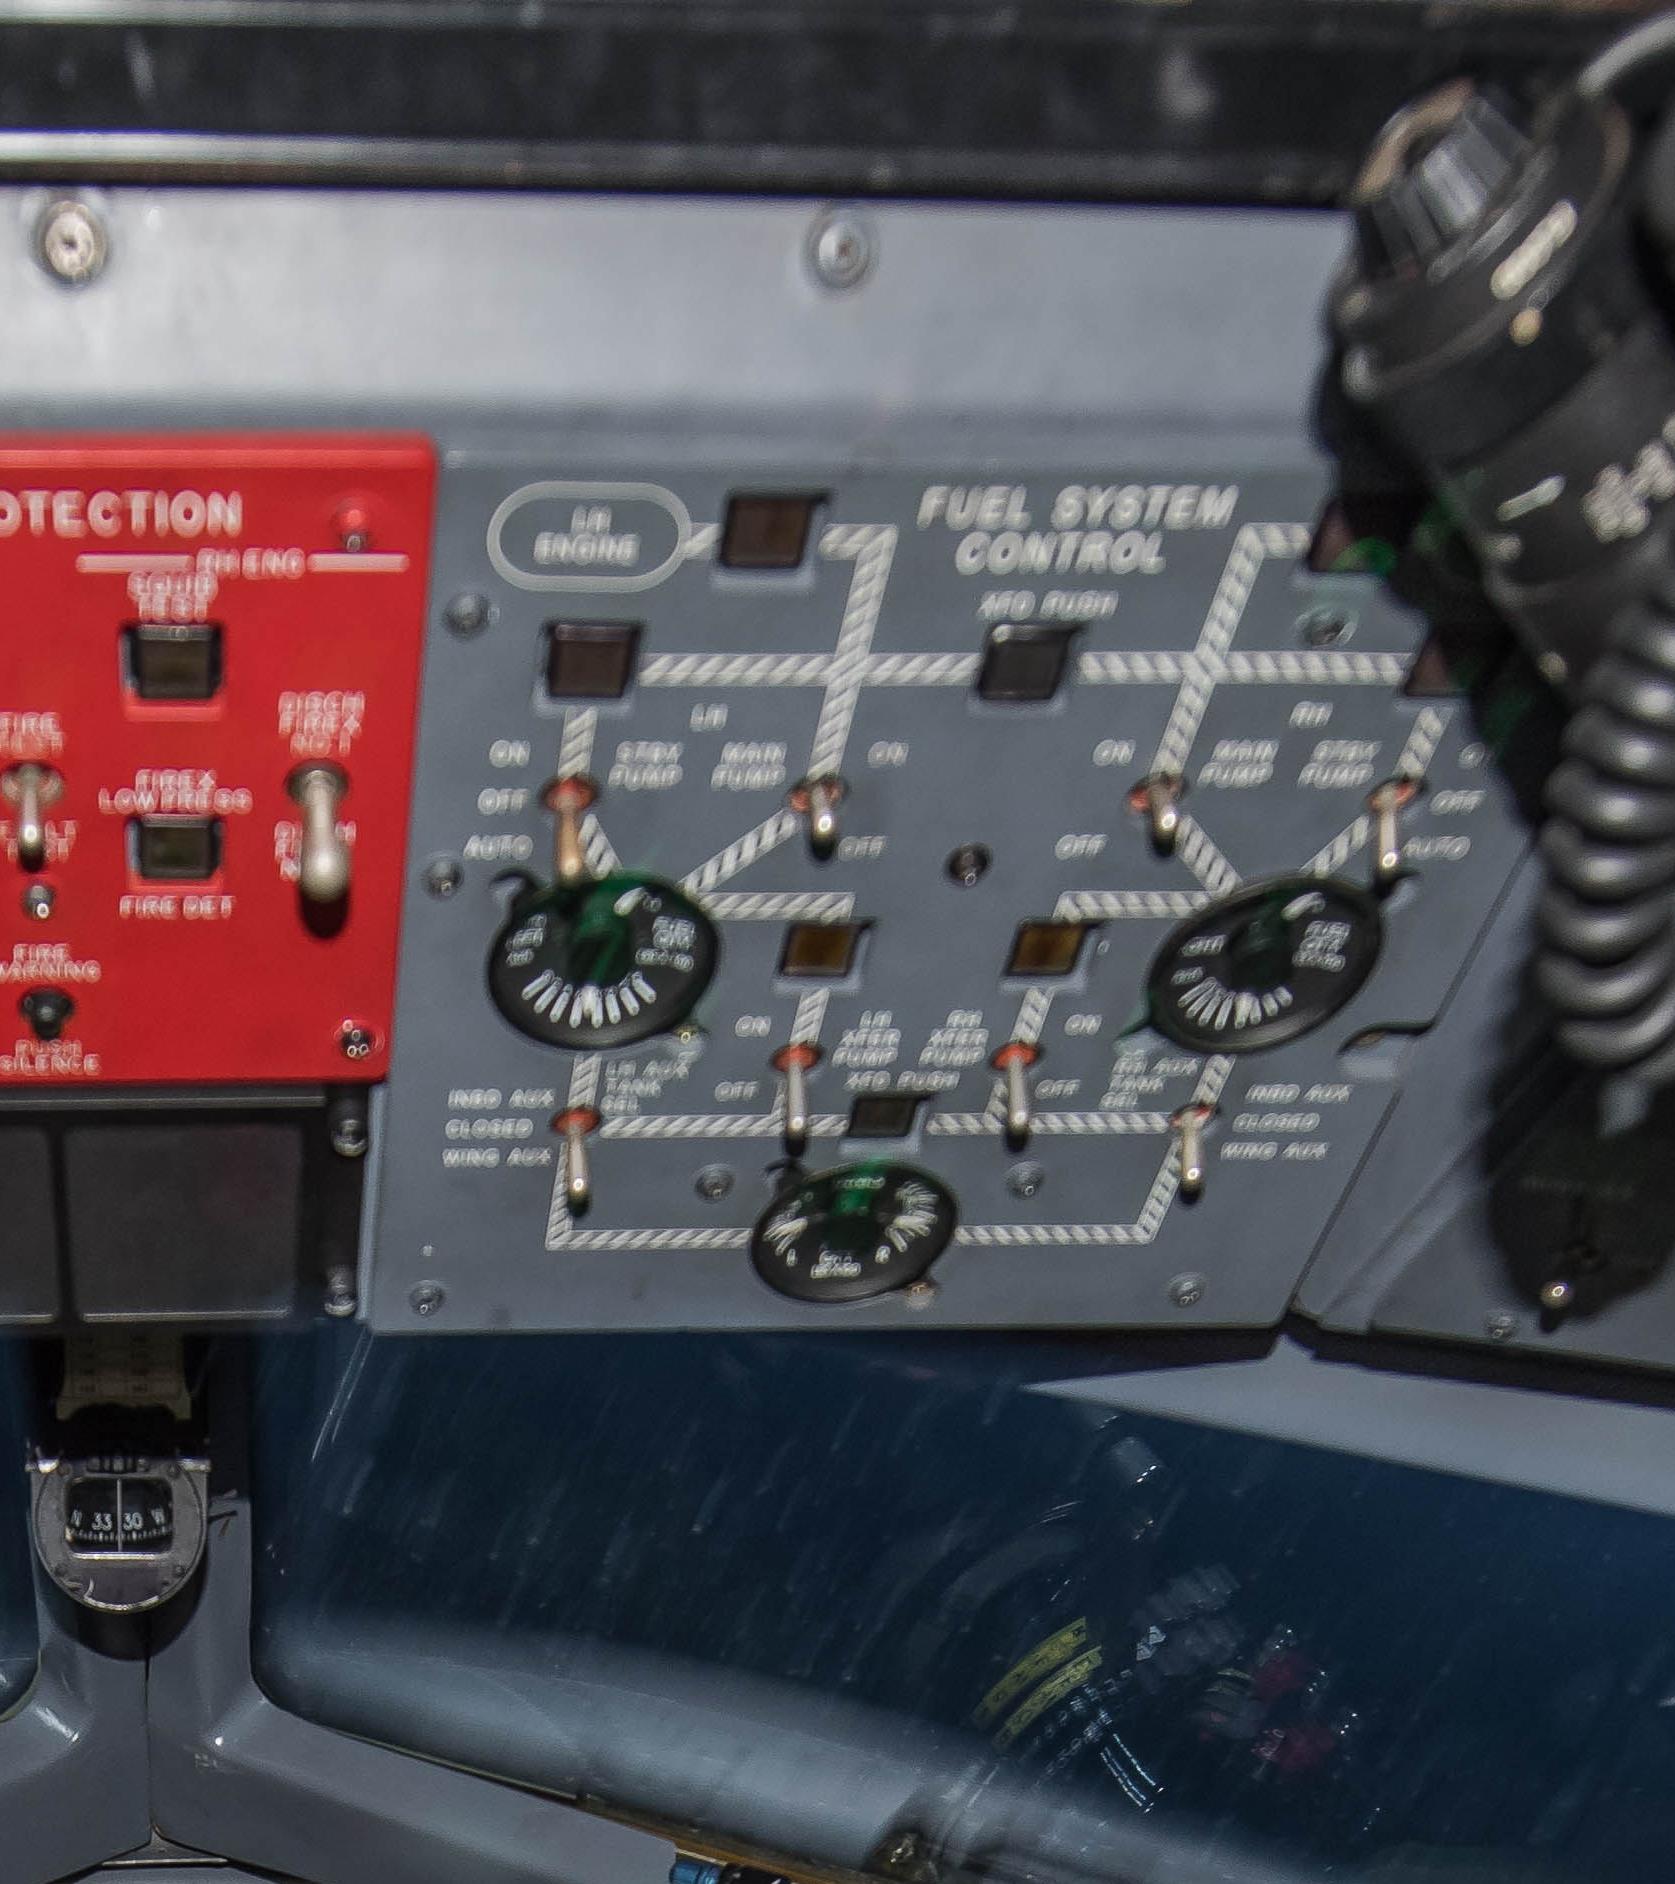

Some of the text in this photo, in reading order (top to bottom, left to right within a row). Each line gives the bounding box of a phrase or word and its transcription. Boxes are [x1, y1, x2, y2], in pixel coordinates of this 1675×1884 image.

[917, 484, 1240, 530] FUEL SYSTEM
[534, 531, 641, 566] ENGINE
[955, 531, 1166, 575] CONTROL
[489, 738, 531, 768] ON
[1092, 738, 1136, 767] ON
[445, 1117, 534, 1140] CLOSED
[91, 1512, 143, 1531] 33 30
